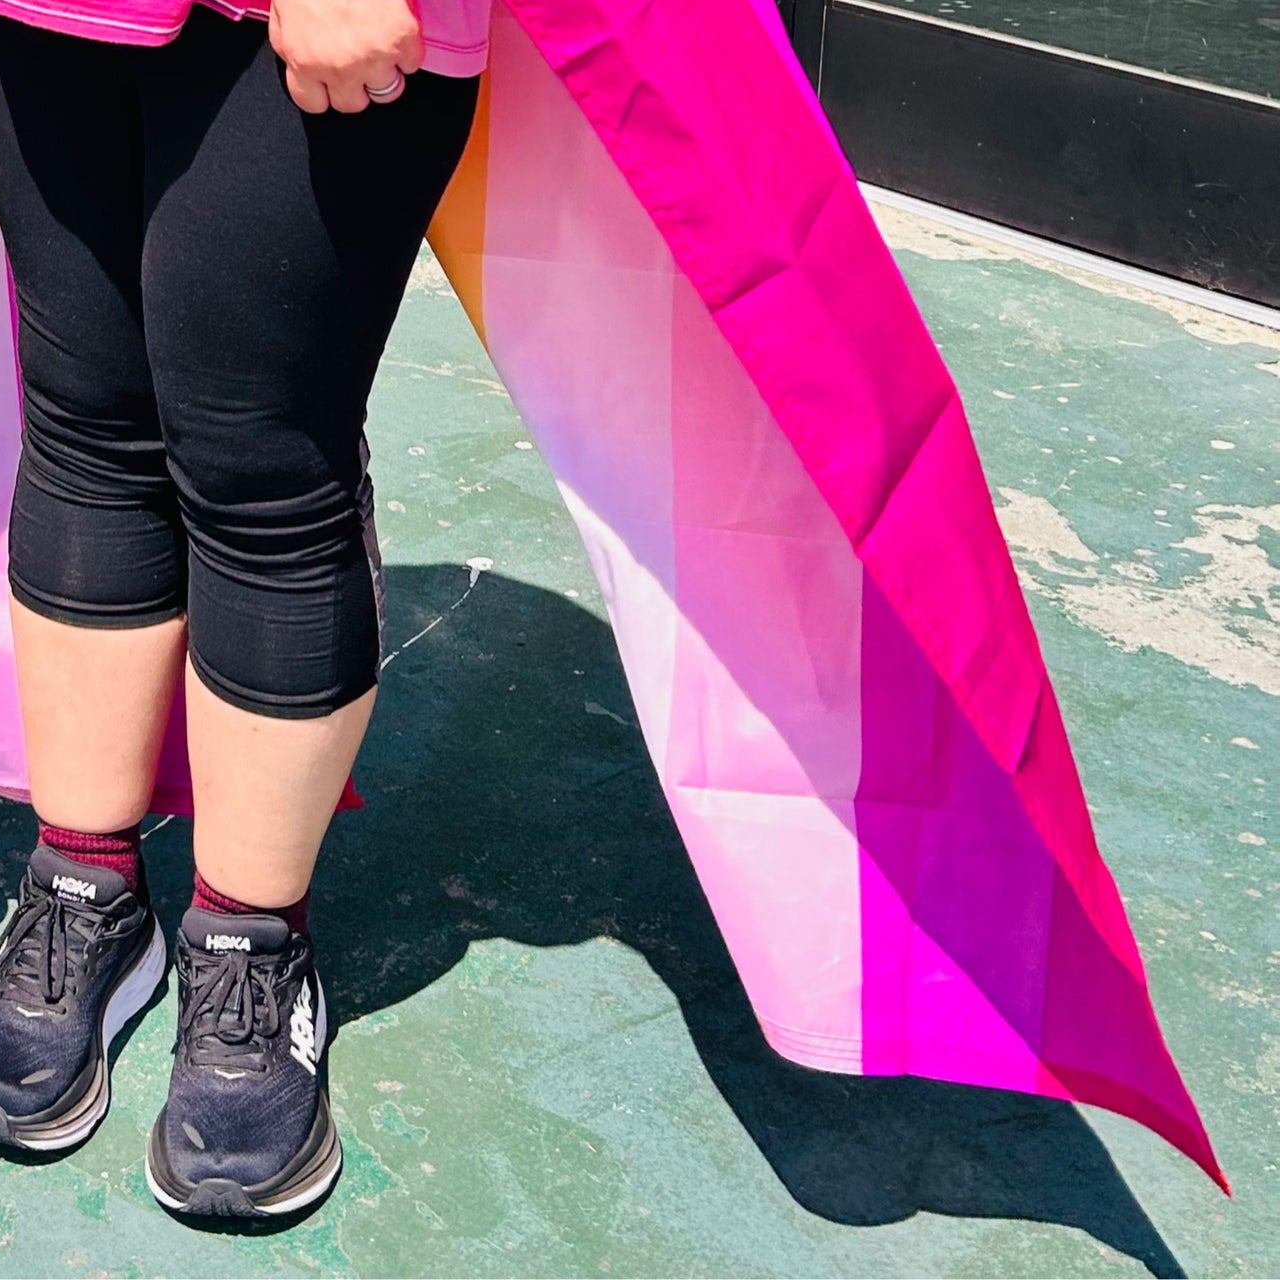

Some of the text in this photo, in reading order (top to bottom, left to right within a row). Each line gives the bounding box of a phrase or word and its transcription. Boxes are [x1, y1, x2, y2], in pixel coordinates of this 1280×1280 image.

[52, 874, 97, 900] HOKA
[206, 934, 251, 951] HOKA
[290, 975, 317, 1075] HOKA
